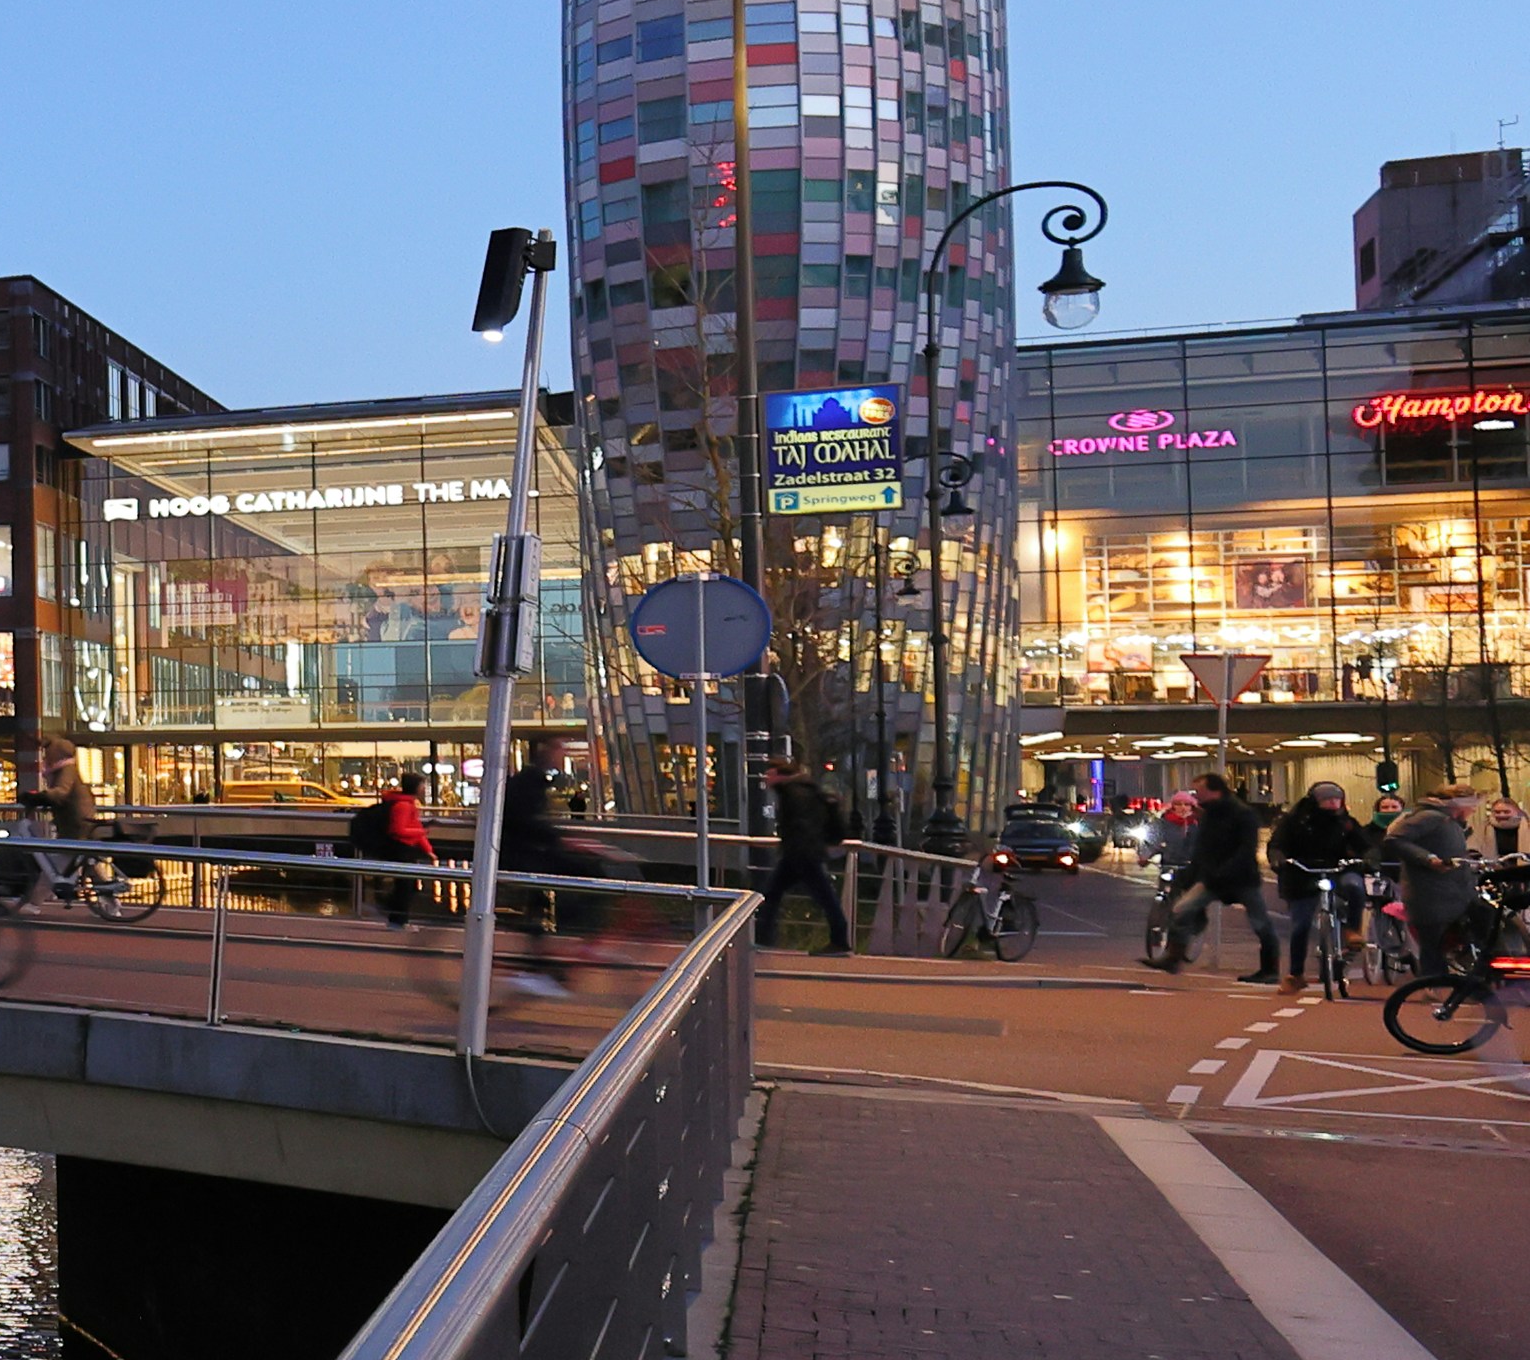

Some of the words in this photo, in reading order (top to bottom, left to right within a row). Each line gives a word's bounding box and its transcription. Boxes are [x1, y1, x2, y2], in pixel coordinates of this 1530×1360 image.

[1353, 391, 1528, 428] Hampton
[772, 444, 806, 470] TAJ
[813, 439, 896, 464] MAHAL
[1047, 435, 1150, 456] CROWNE
[1158, 431, 1237, 450] PLAZA
[774, 471, 870, 487] Zadelstraat
[874, 467, 896, 480] 32
[149, 494, 230, 518] HOOG
[236, 485, 404, 512] CATHARIJNE
[412, 481, 465, 502] THE
[803, 494, 876, 506] Springweg
